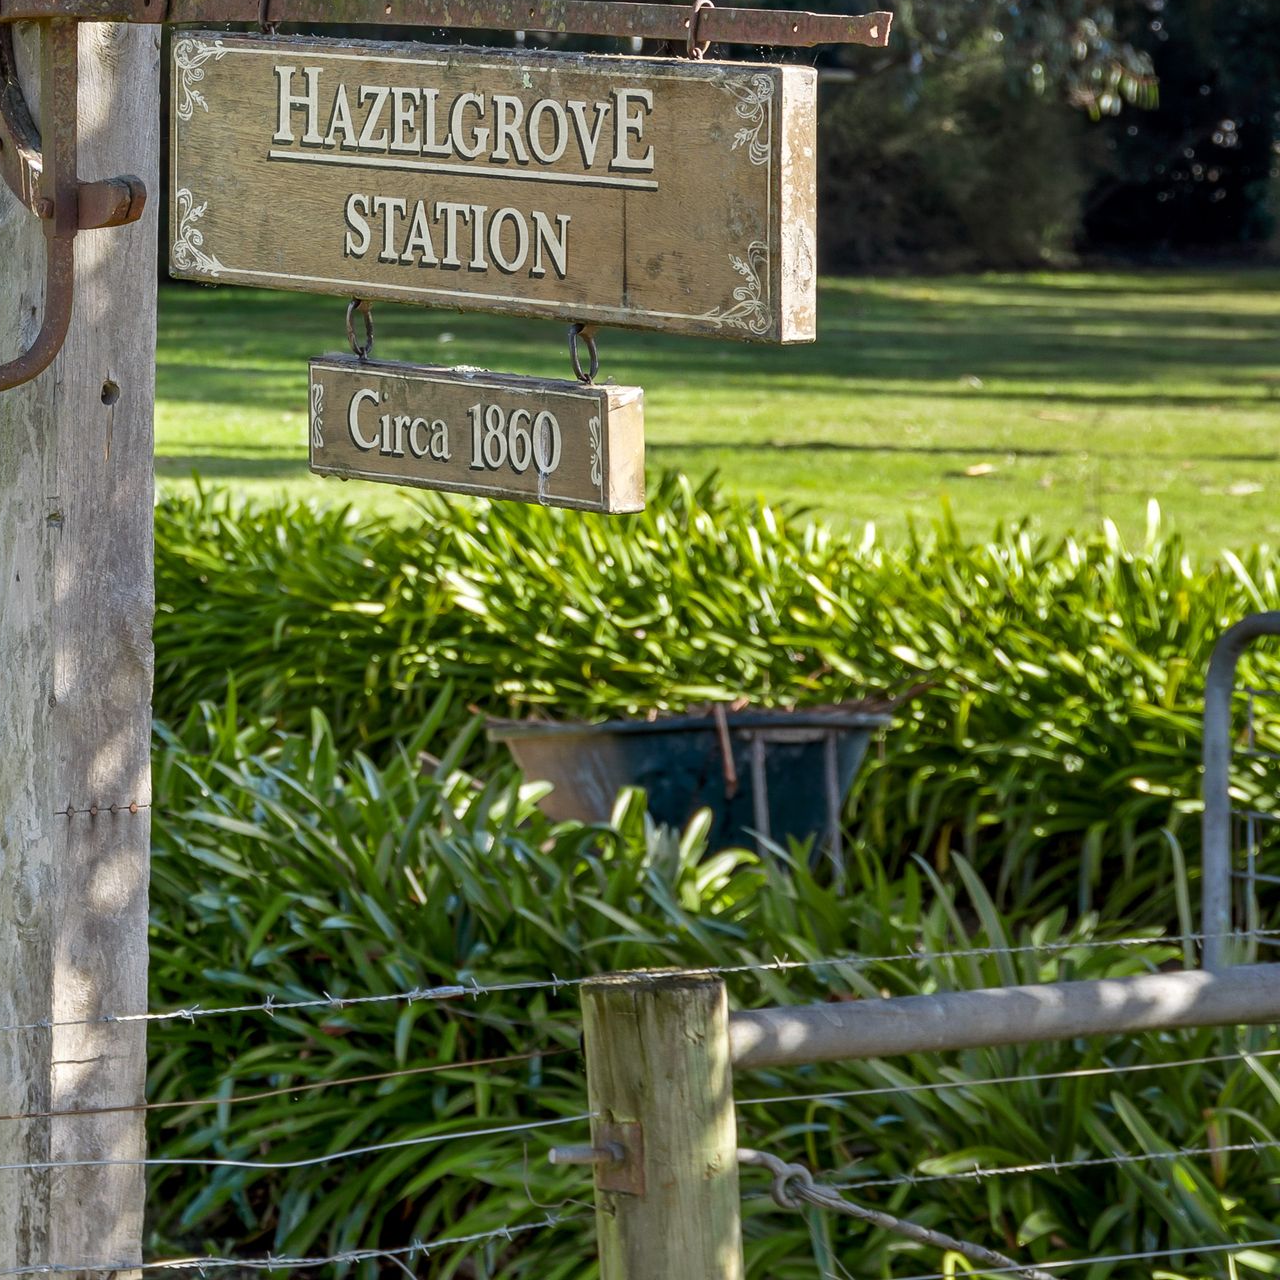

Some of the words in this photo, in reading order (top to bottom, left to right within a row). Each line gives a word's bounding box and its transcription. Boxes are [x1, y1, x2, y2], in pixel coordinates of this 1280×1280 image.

[272, 65, 655, 172] HAZELGROVE
[343, 192, 571, 279] STATION
[348, 388, 452, 462] Circa
[467, 403, 562, 474] 1860
